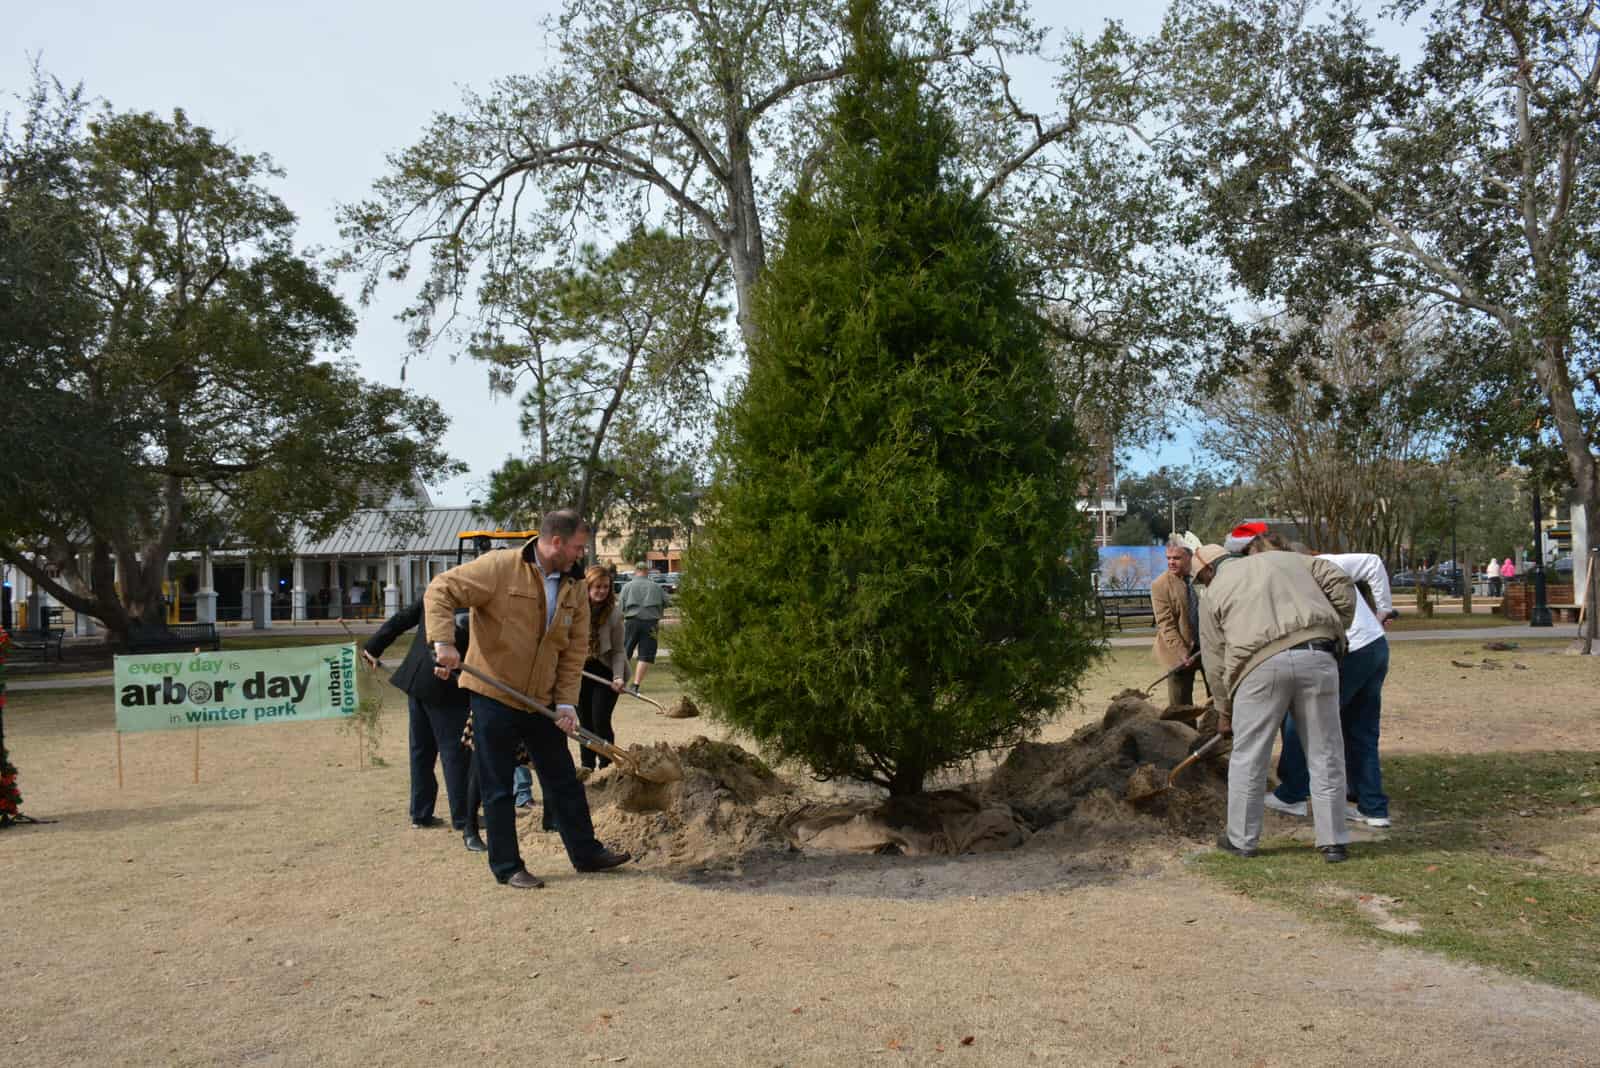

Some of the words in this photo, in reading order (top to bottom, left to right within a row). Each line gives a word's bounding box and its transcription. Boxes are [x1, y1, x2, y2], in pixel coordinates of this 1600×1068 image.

[128, 660, 182, 676] every
[189, 657, 223, 673] day
[229, 661, 240, 671] is
[328, 659, 341, 707] urban
[341, 648, 354, 713] forestry
[121, 676, 230, 707] arbor
[242, 671, 311, 703] day
[170, 714, 181, 724] in
[186, 705, 247, 723] winter
[254, 702, 297, 720] park
